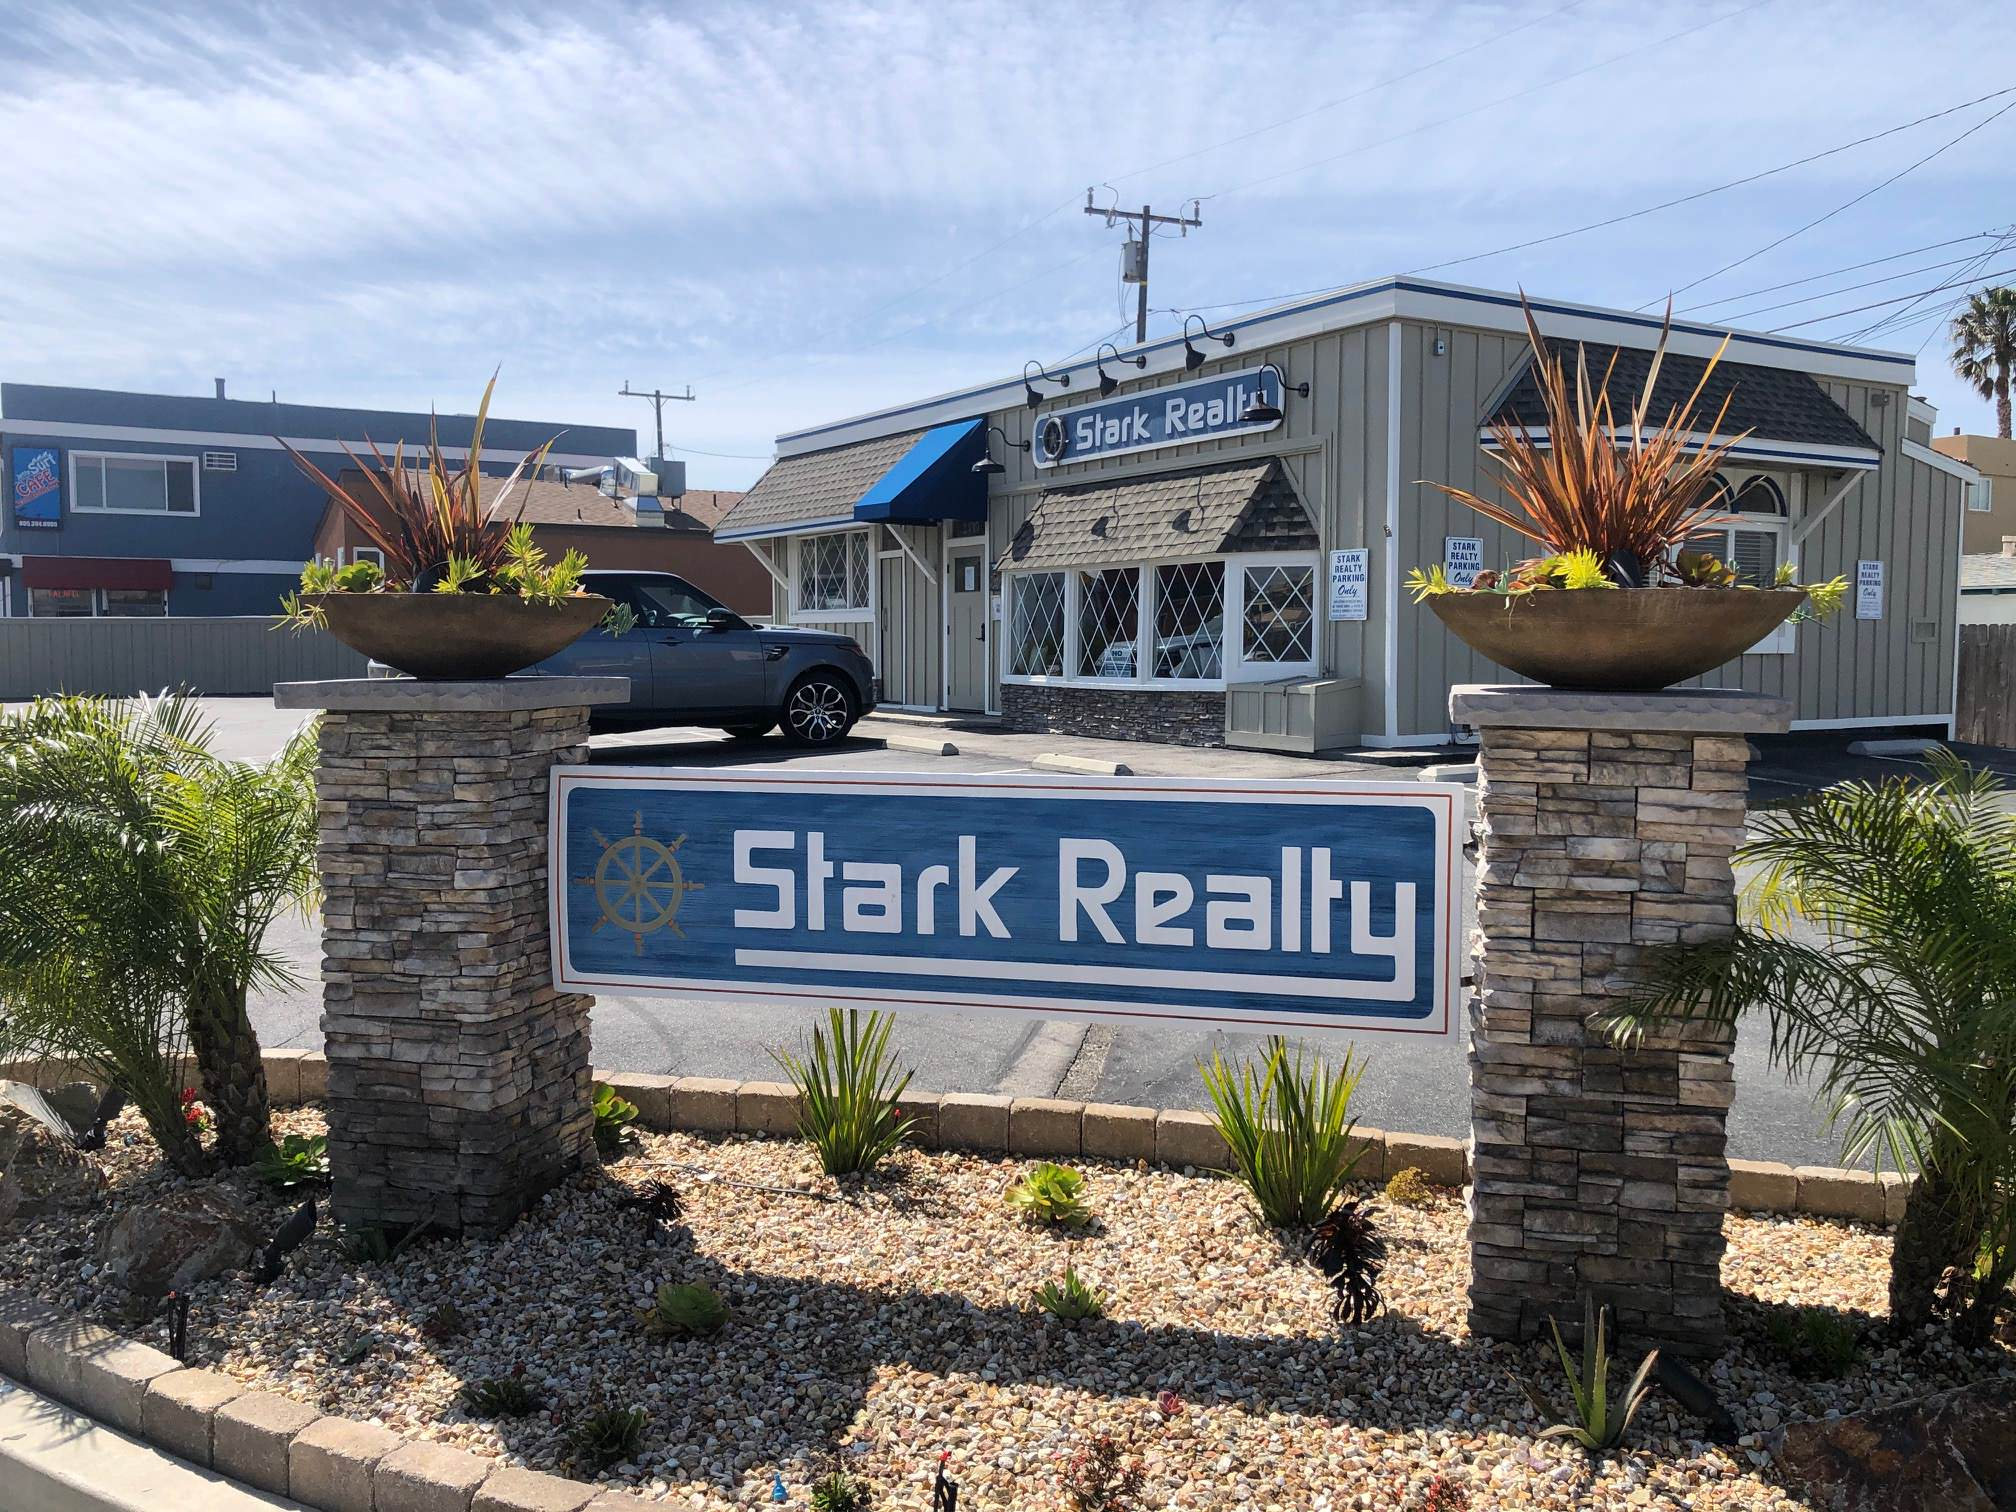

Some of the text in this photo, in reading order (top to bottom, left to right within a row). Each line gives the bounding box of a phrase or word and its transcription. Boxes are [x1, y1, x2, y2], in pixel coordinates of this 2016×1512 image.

[1076, 406, 1150, 450] Stark
[1453, 542, 1476, 551] STARK
[1337, 554, 1361, 563] STARK
[1451, 552, 1478, 561] REALTY
[1334, 564, 1362, 573] REALTY
[1448, 561, 1480, 570] PARKING
[1332, 573, 1365, 583] PARKING
[1454, 571, 1474, 585] Only
[1337, 584, 1358, 598] Only
[733, 829, 1416, 1002] Stark Realty
